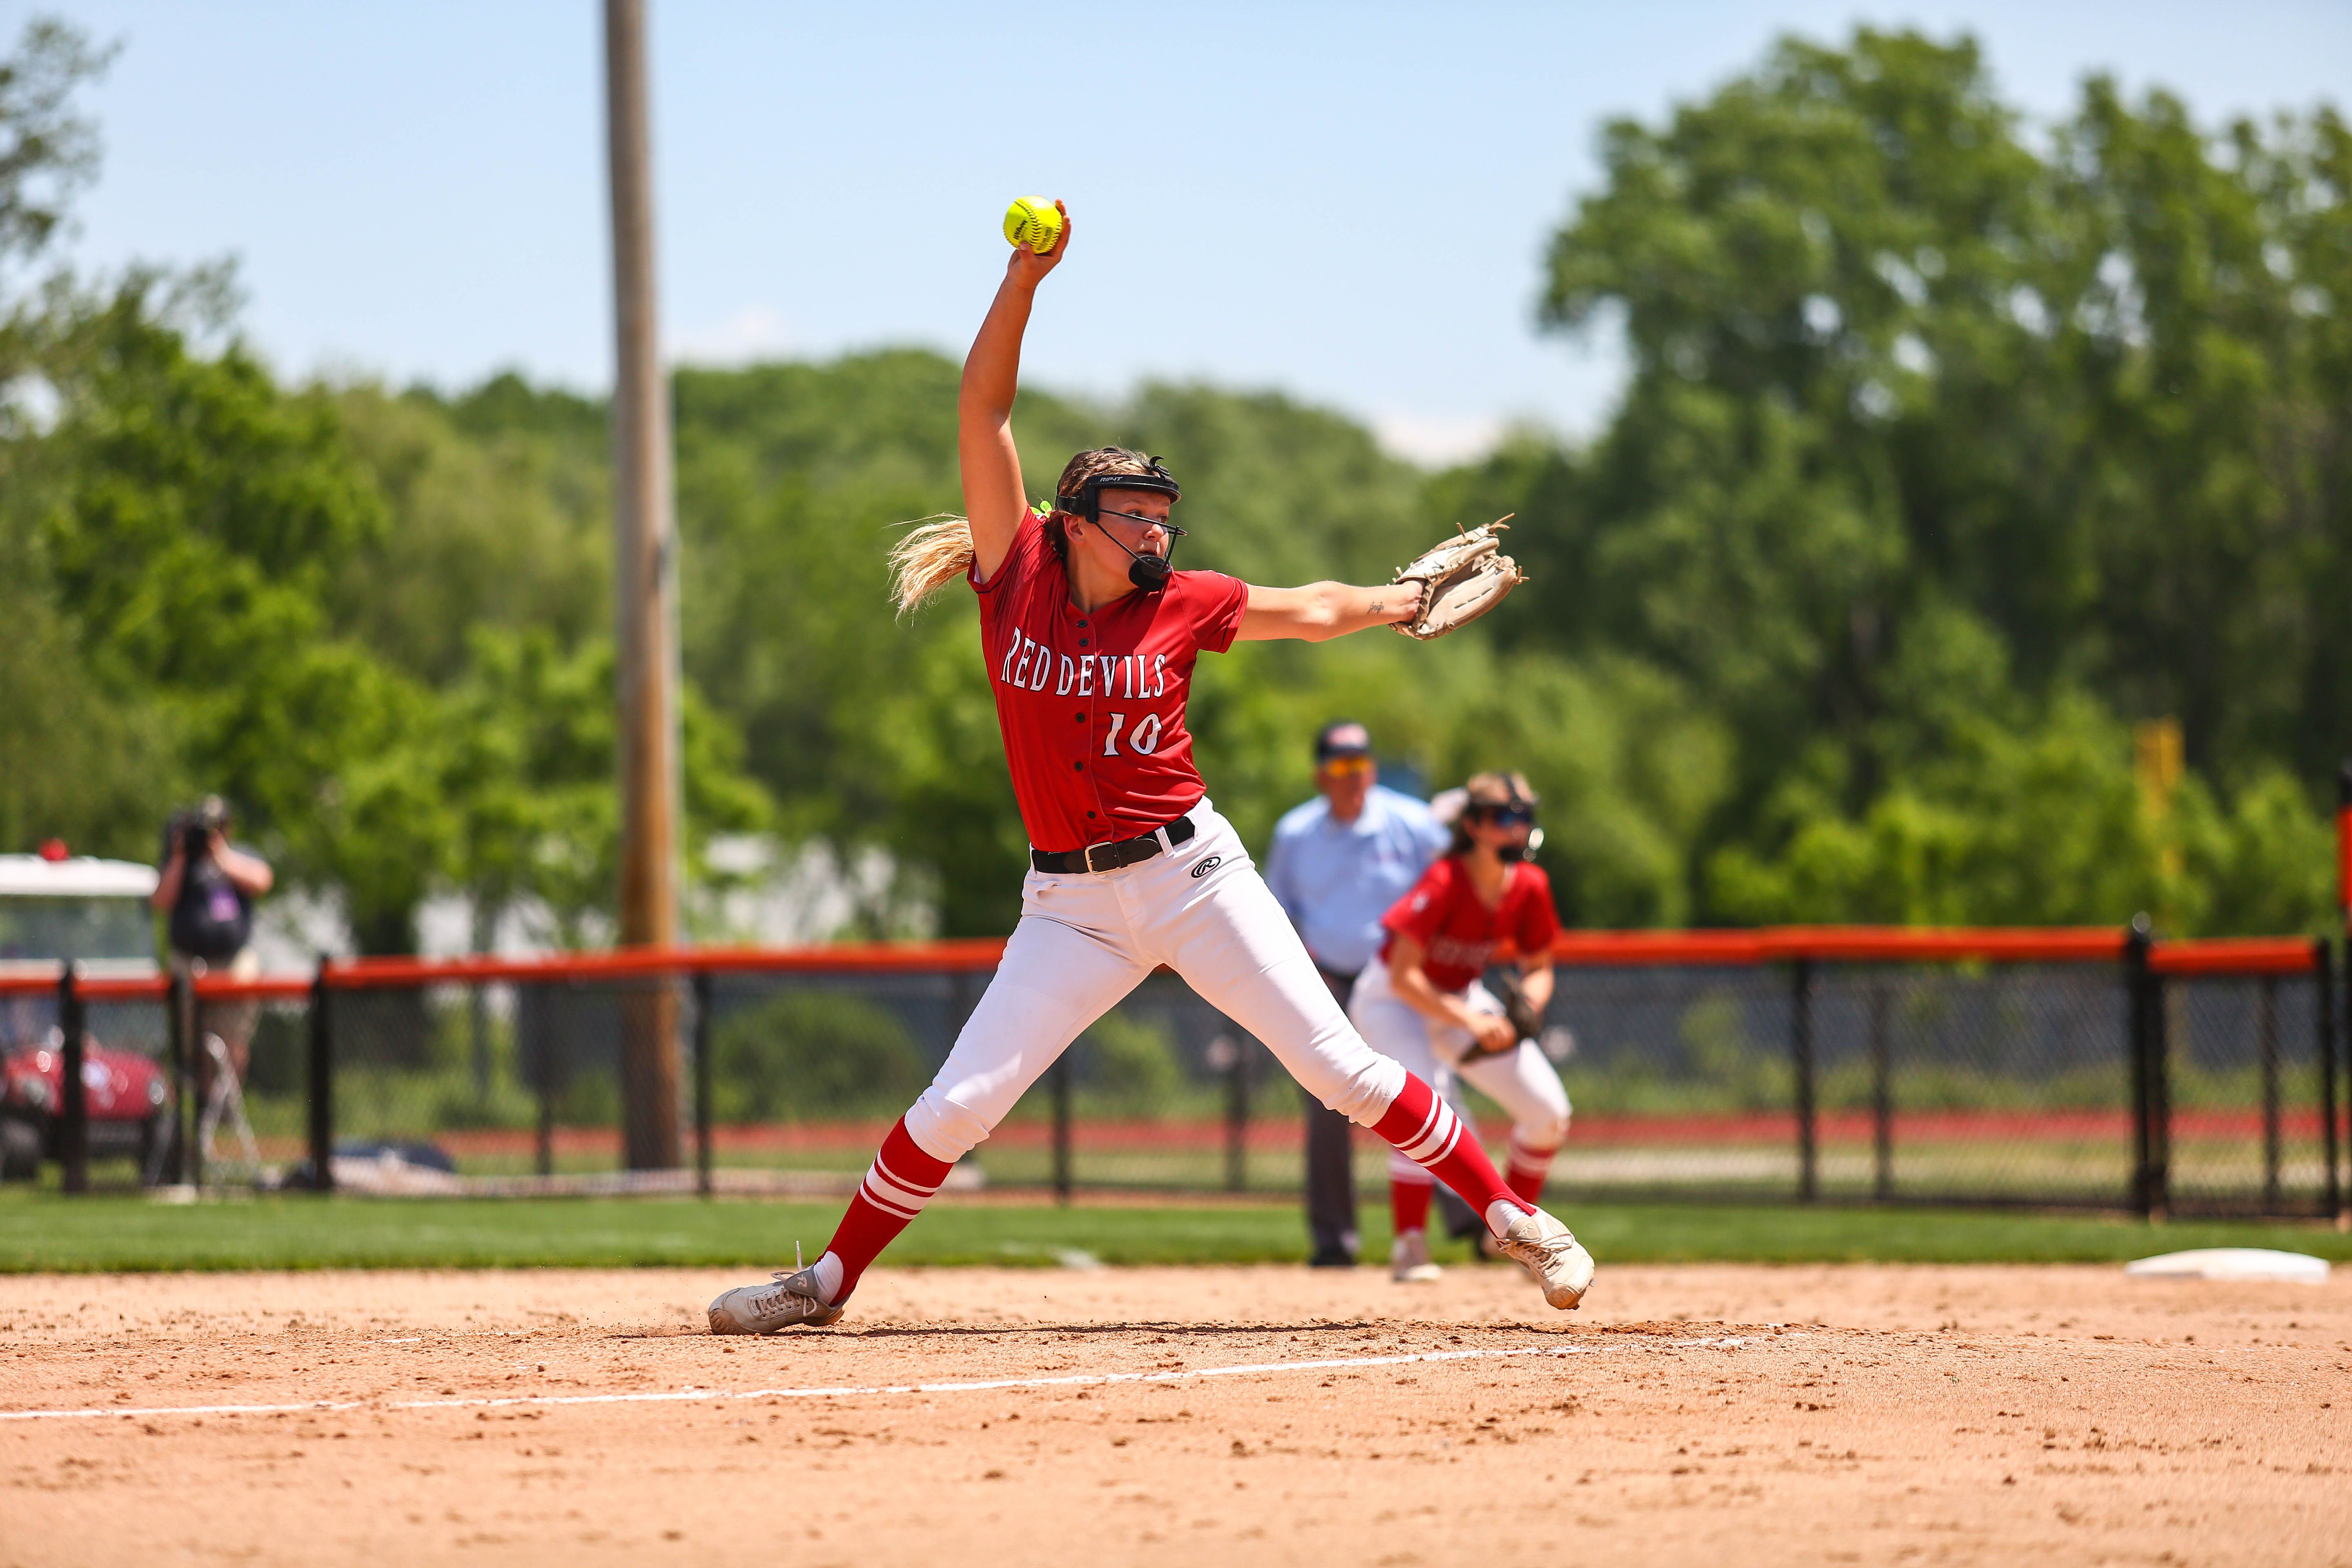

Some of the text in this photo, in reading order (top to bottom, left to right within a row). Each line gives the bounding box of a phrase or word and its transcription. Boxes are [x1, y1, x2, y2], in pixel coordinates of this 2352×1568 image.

[1000, 626, 1166, 699] RED DEVILS
[1102, 713, 1163, 757] 10
